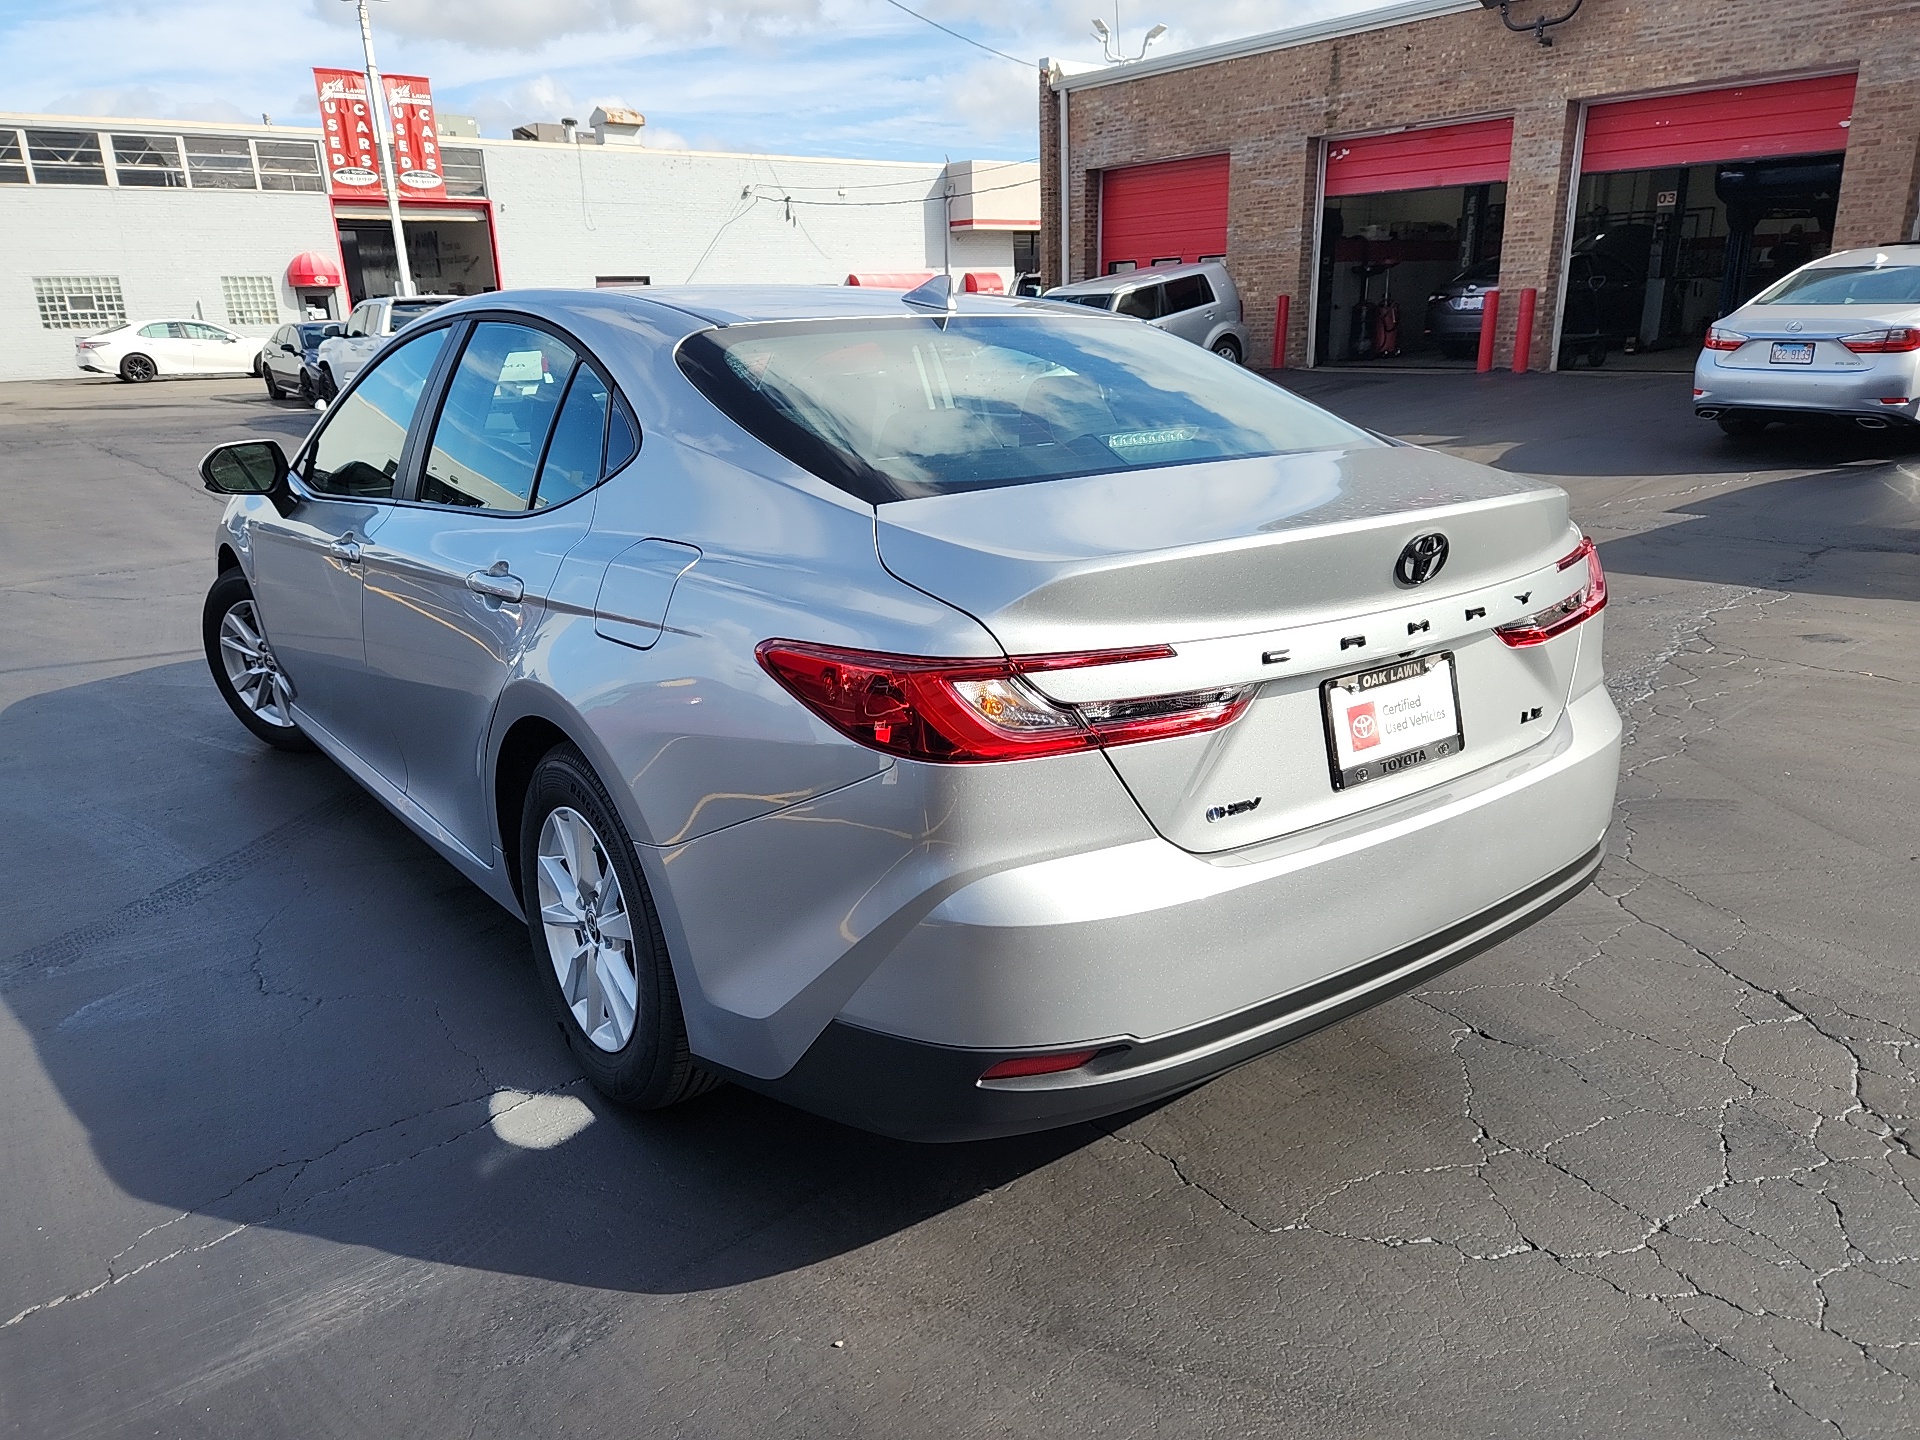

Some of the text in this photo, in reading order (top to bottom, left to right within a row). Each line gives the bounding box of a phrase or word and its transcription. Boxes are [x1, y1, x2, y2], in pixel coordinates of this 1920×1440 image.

[324, 102, 345, 166] USED
[353, 104, 372, 167] CARS
[393, 107, 412, 169] USED
[419, 109, 437, 170] CARS
[1658, 193, 1676, 205] 03
[1262, 591, 1533, 665] CAMRY
[1362, 662, 1421, 688] OAK LAWN
[1382, 695, 1422, 716] Certified
[1520, 706, 1544, 724] LE
[1385, 708, 1446, 735] Used Vehicles
[1380, 750, 1427, 774] TOYOTA
